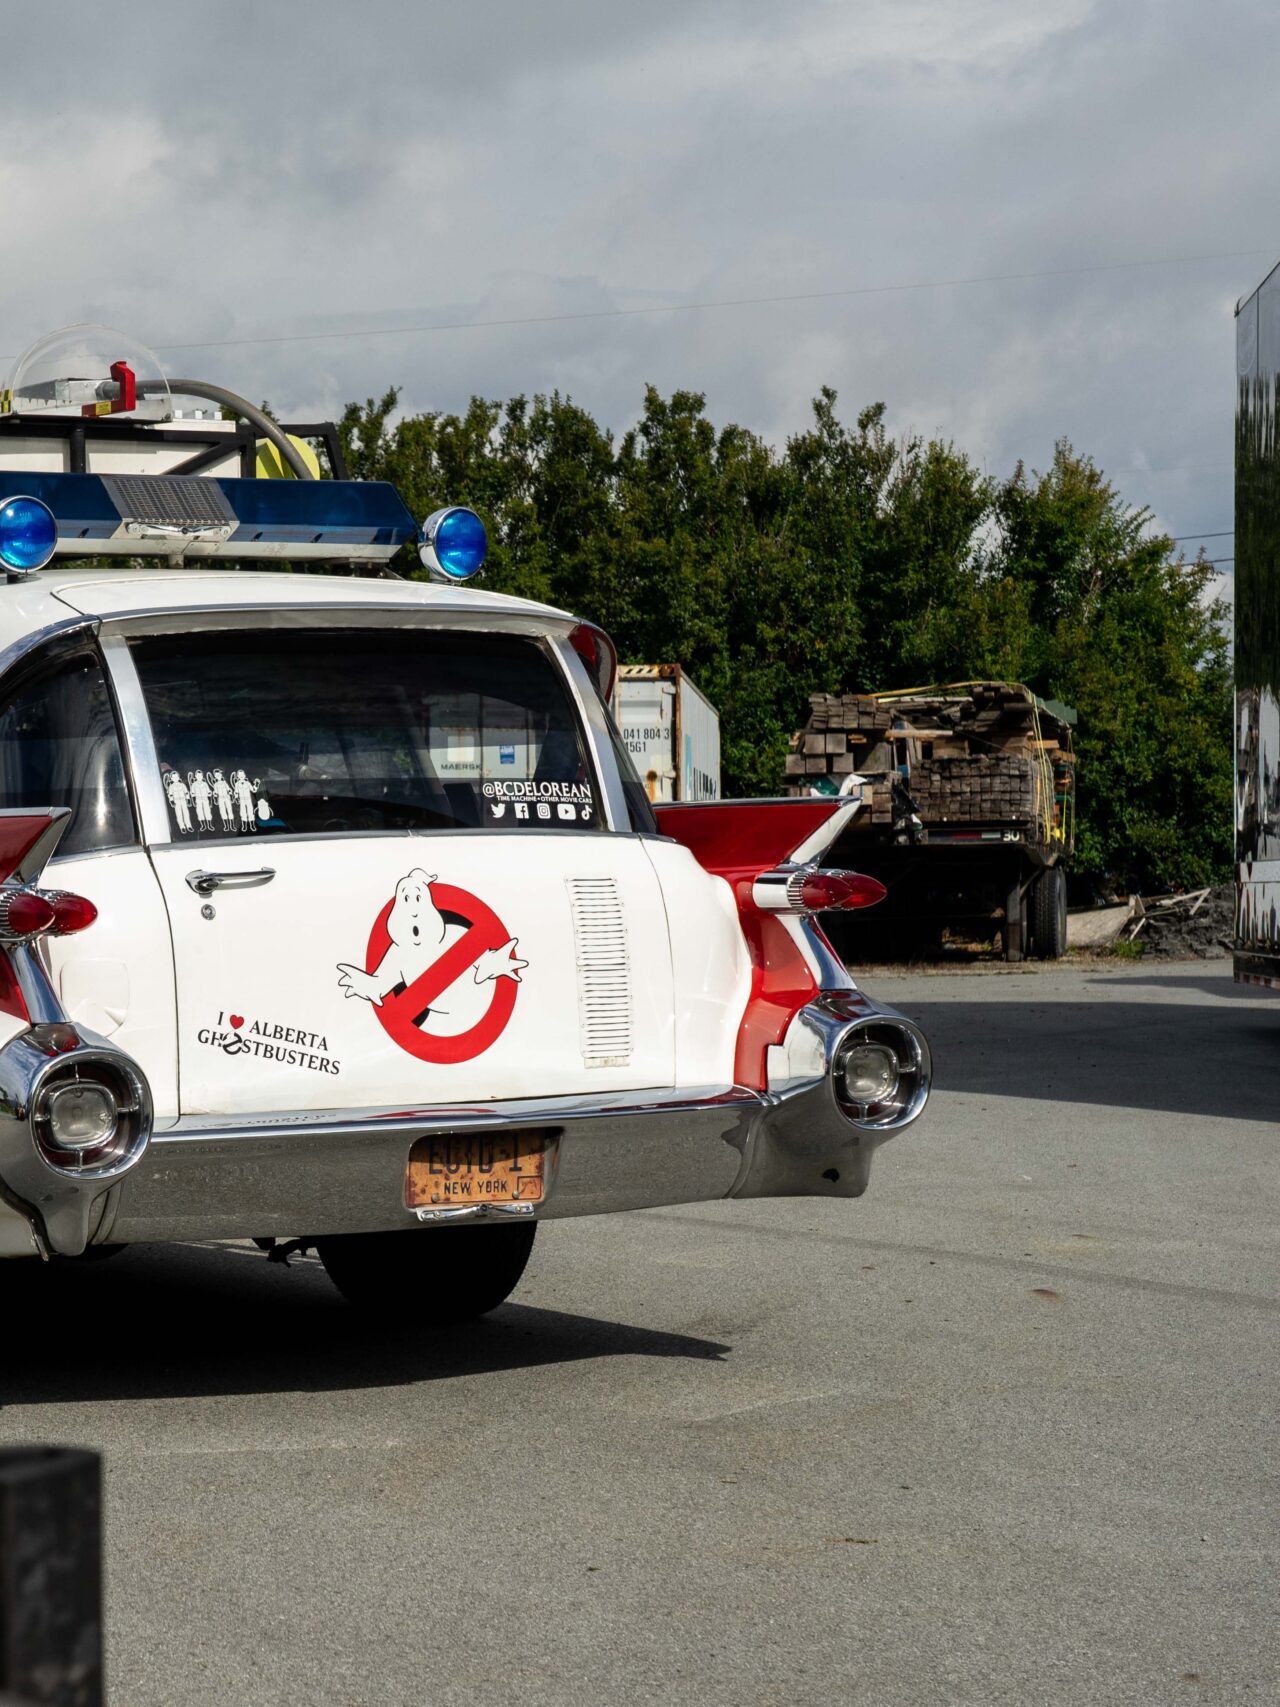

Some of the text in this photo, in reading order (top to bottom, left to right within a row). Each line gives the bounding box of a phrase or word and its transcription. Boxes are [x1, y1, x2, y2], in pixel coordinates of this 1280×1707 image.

[624, 728, 670, 739] 041 804 3
[483, 781, 592, 798] @BCDELOREAN
[217, 1011, 328, 1051] I ALBERTA
[444, 1181, 508, 1194] NEW YORK
